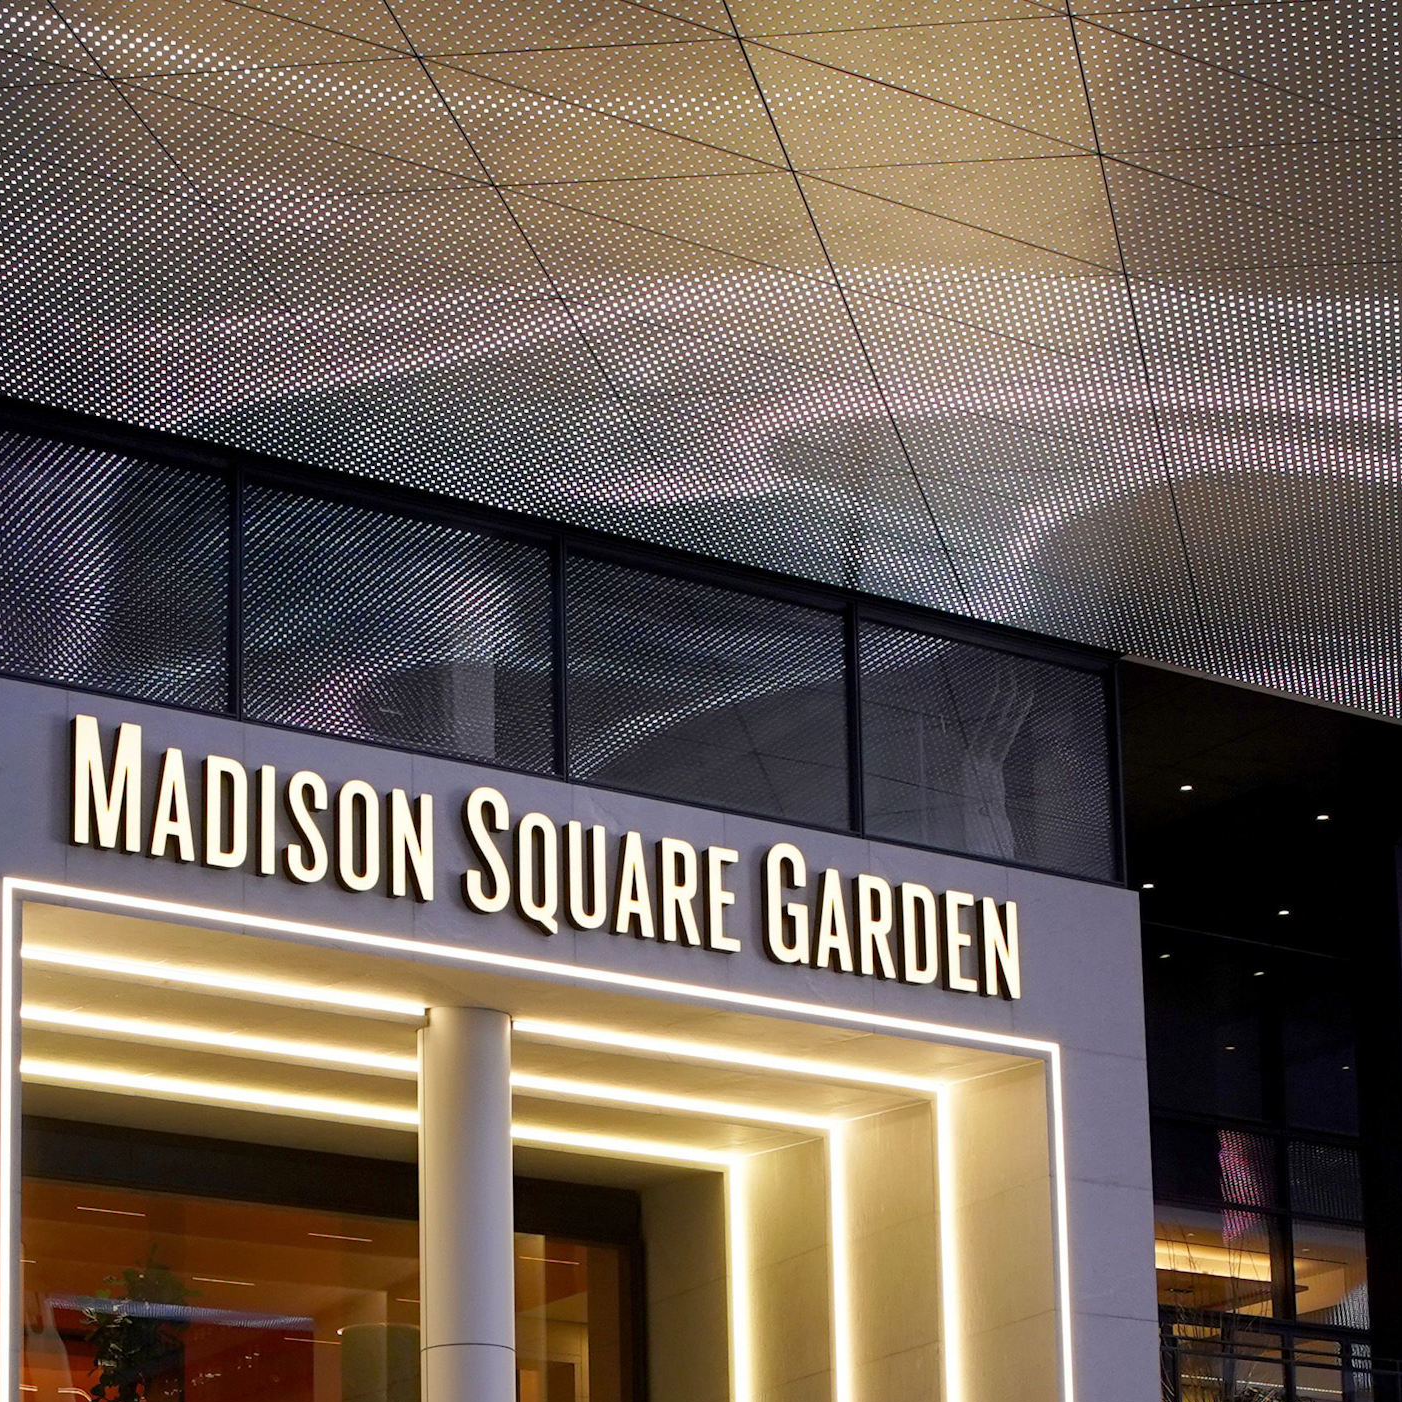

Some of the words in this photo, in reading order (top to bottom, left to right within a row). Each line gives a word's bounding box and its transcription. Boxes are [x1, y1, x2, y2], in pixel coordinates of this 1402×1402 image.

[71, 713, 434, 903] MADISON
[464, 786, 741, 954] SQUARE
[764, 842, 1022, 999] GARDEN
